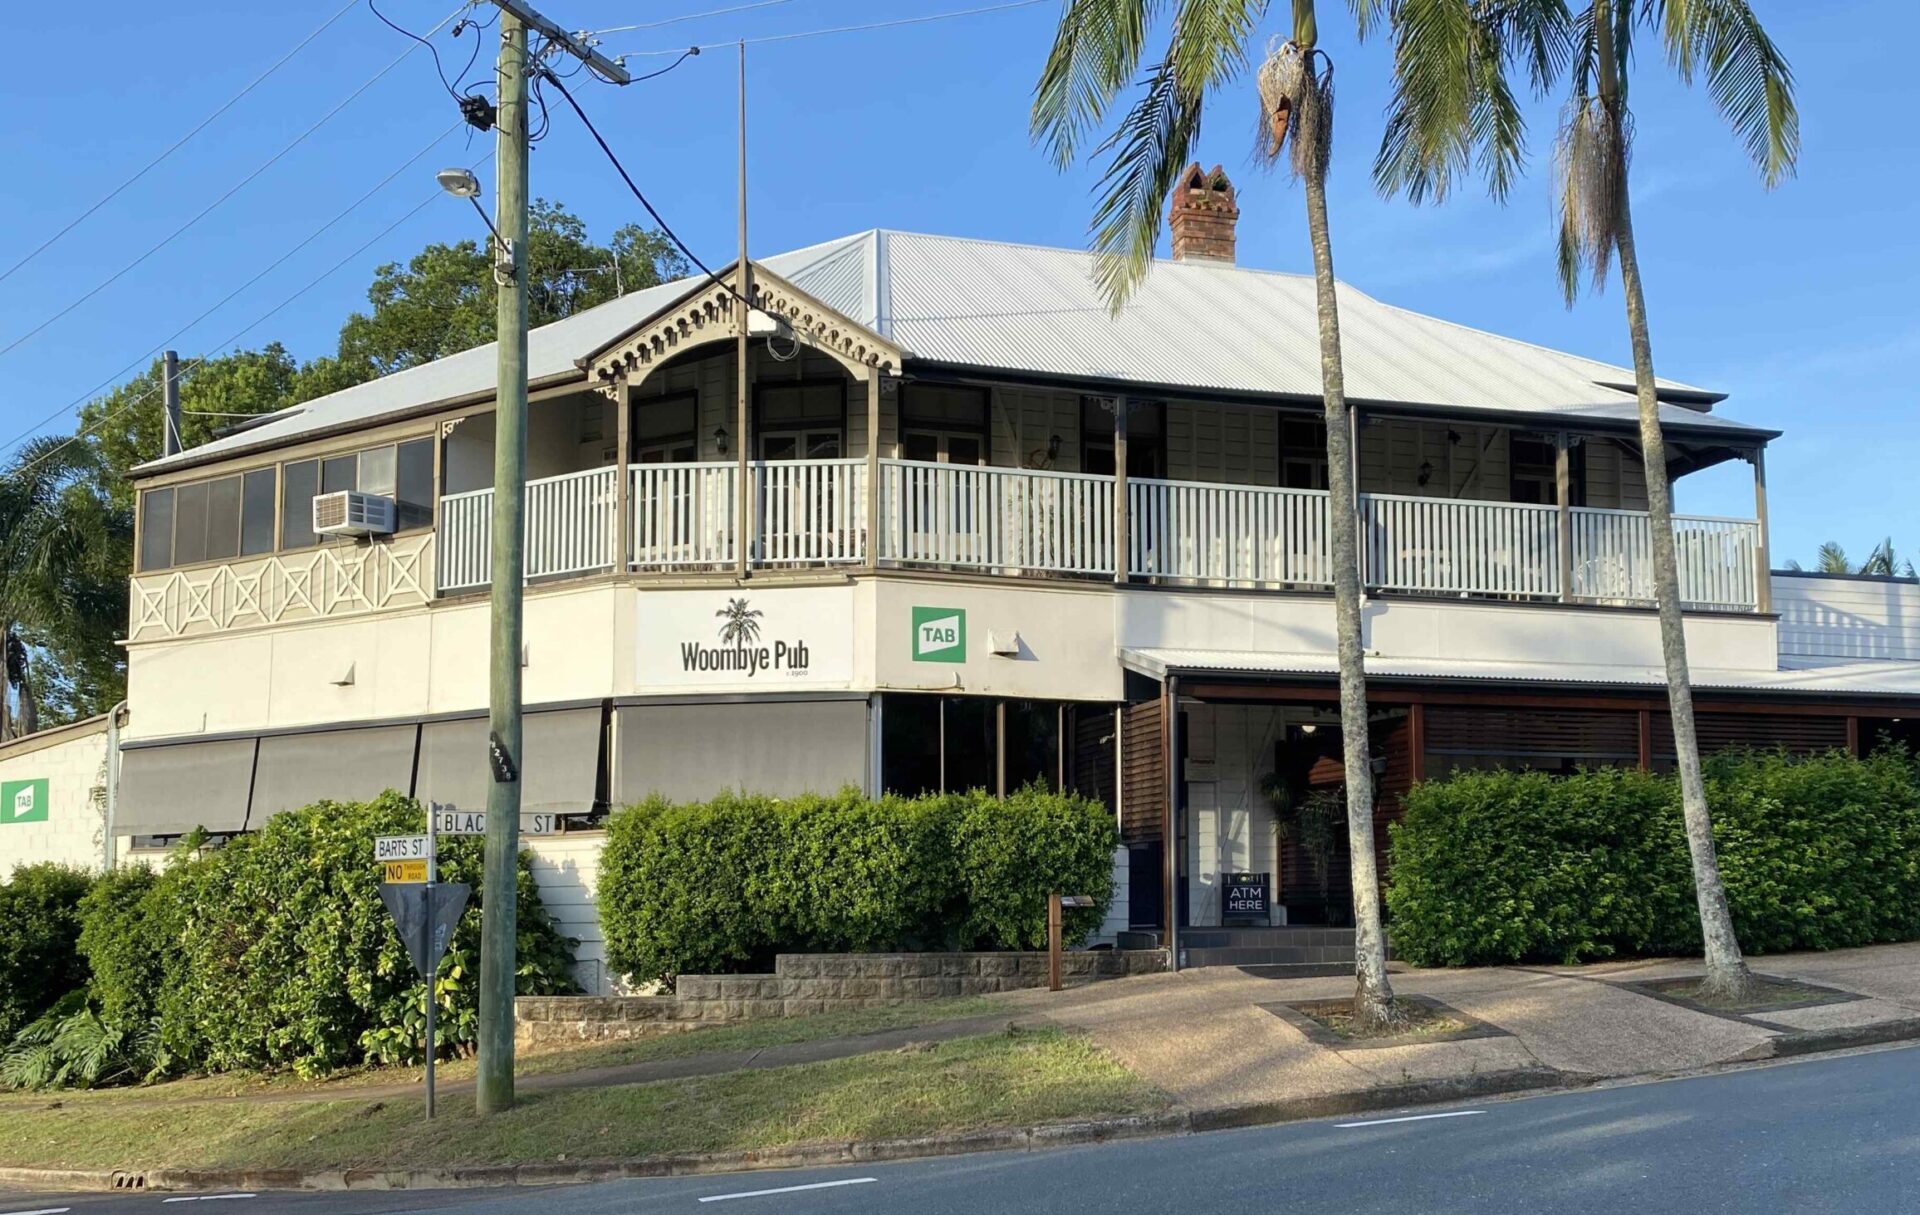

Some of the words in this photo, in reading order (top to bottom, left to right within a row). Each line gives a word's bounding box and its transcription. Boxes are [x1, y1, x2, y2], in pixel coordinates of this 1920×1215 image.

[922, 627, 955, 643] TAB
[681, 640, 769, 677] Woombye
[775, 640, 809, 669] Pub
[17, 795, 32, 808] TAB
[445, 814, 525, 832] BLAC
[534, 815, 552, 832] ST
[379, 840, 407, 857] BARTS
[412, 839, 424, 855] ST
[388, 864, 403, 880] NO
[1230, 887, 1262, 898] ATM
[1229, 900, 1263, 910] HERE
